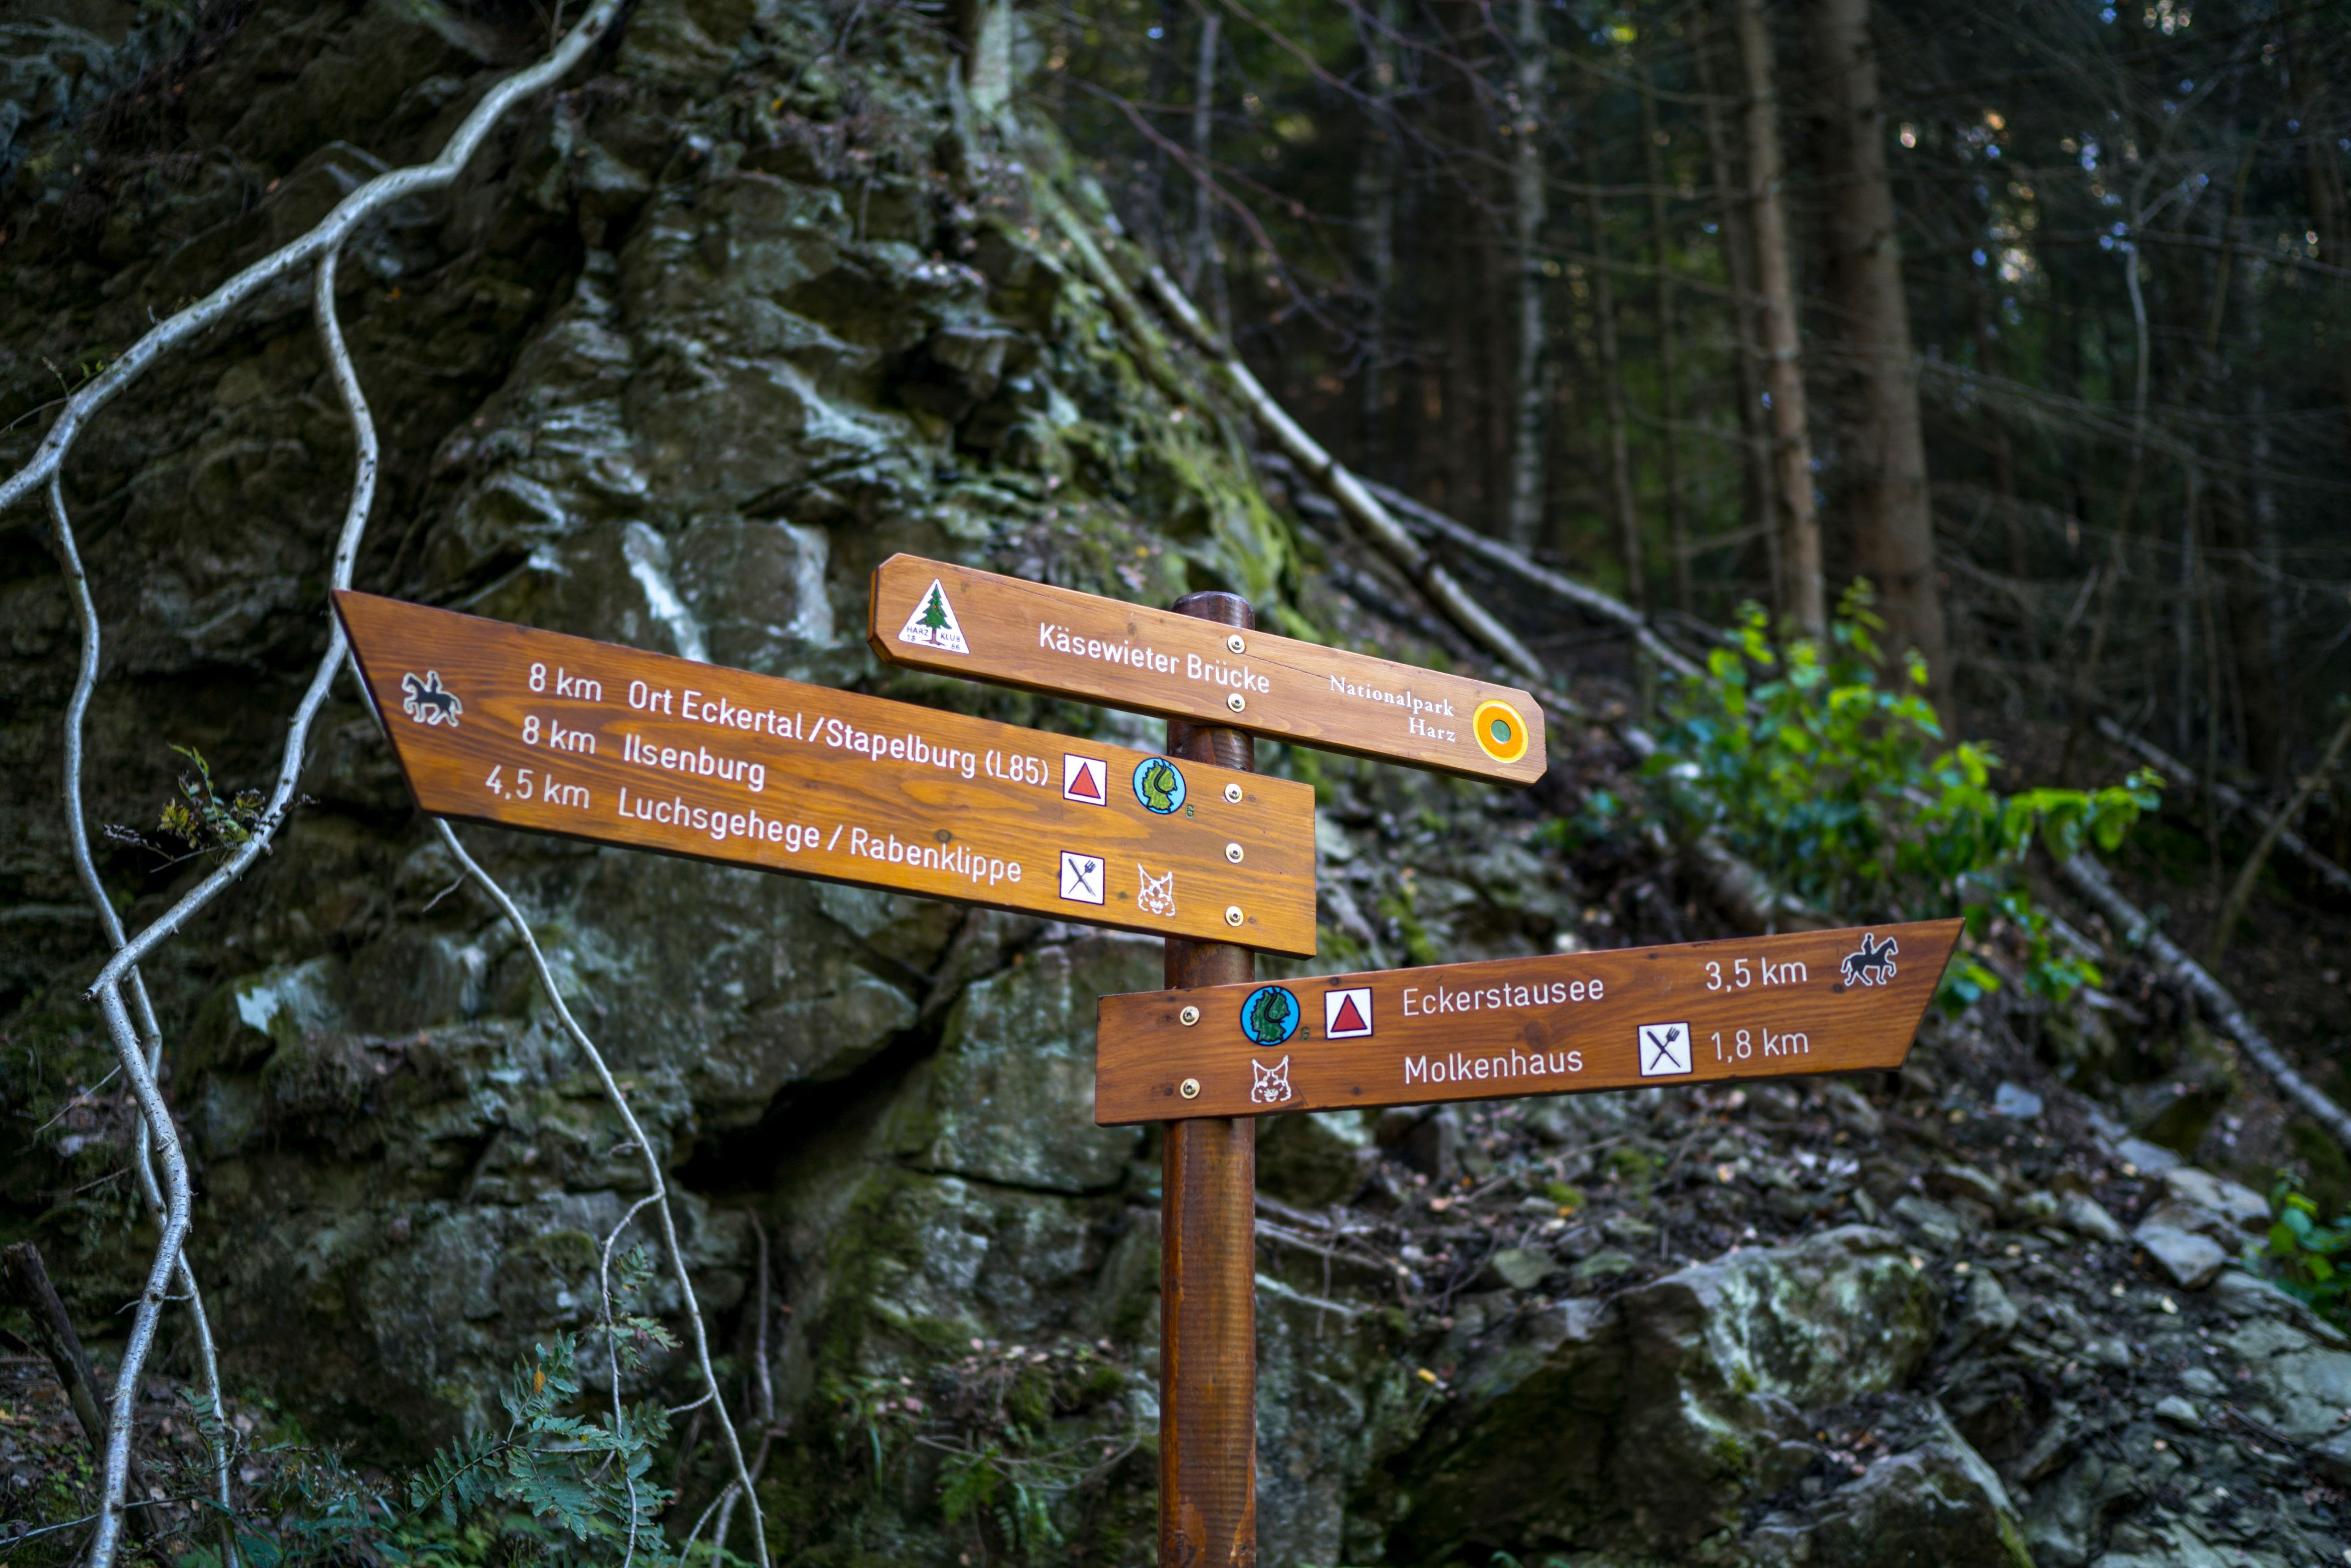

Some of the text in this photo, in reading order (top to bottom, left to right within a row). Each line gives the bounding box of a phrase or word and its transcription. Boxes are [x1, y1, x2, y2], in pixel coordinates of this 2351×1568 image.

[907, 626, 960, 642] HARZ KLUB
[1039, 623, 1270, 694] Käsewieter Brücke
[528, 662, 547, 694] 8
[555, 666, 602, 702] km
[628, 679, 674, 716] Ort
[984, 748, 1049, 787] (L85)
[1330, 675, 1454, 716] Nationalpark
[521, 714, 766, 794] 8 km Ilsenburg
[1409, 717, 1456, 743] Harz
[484, 763, 534, 801] 4,5
[543, 773, 590, 810] km
[617, 786, 821, 853] Luchsgehege
[849, 826, 1022, 886] Rabenklippe
[1403, 956, 1808, 1017] Eckerstausee 3,5 km
[1404, 1027, 1810, 1085] Molkenhaus 1,8 km
